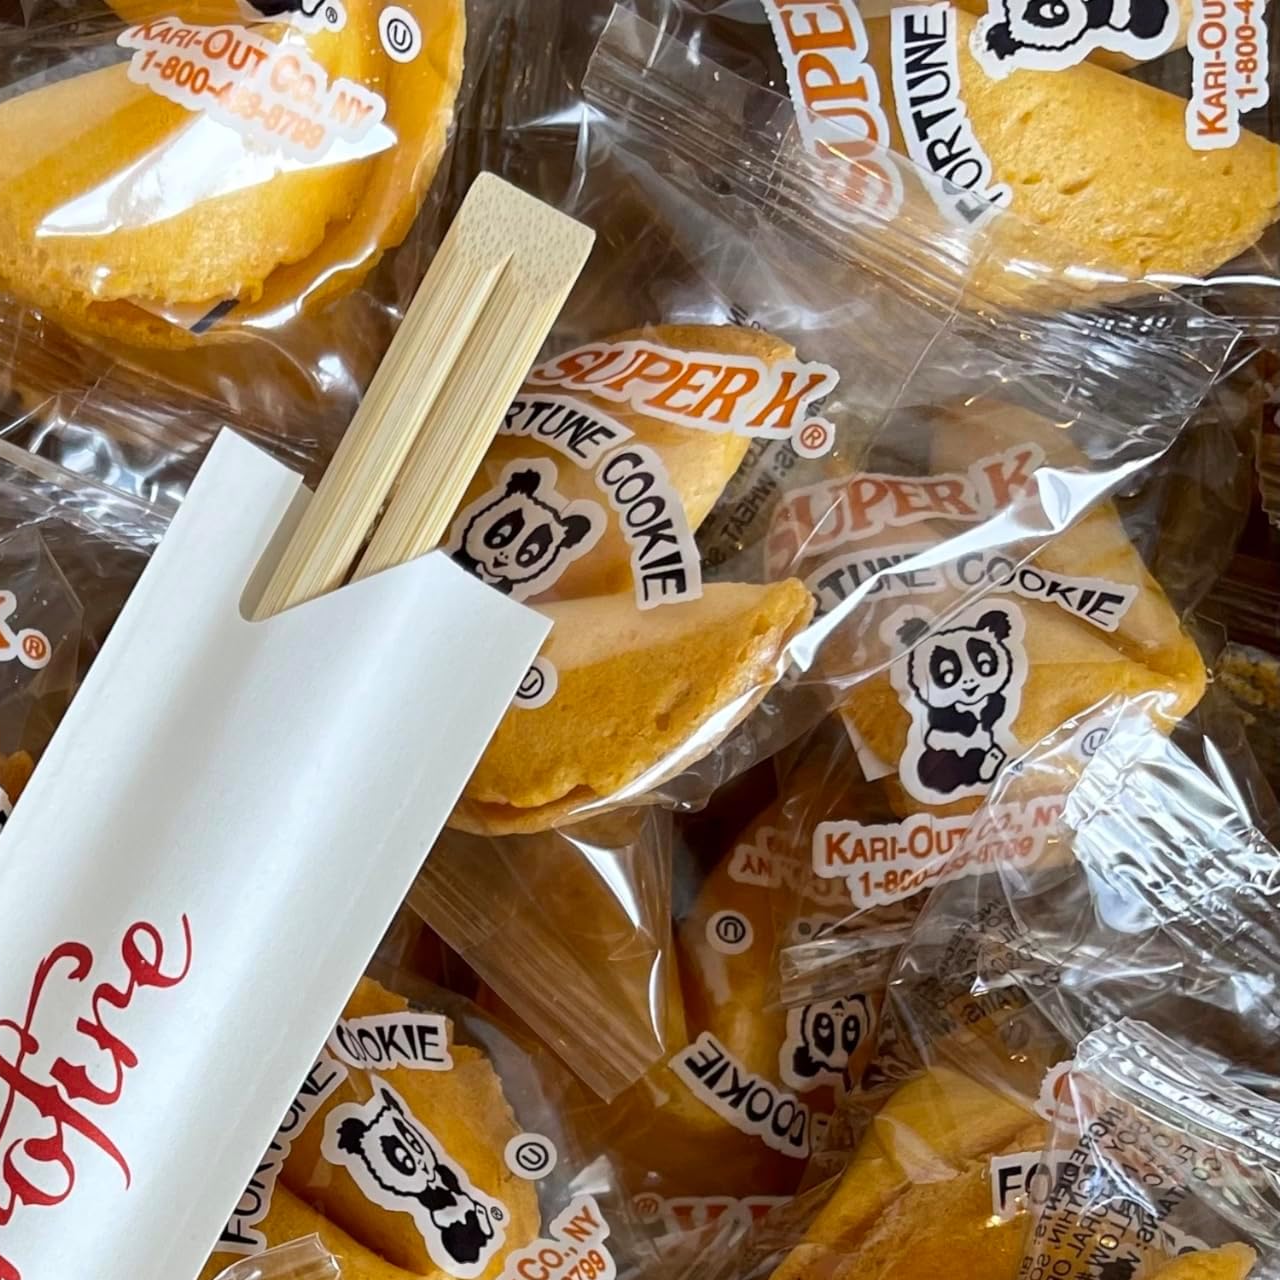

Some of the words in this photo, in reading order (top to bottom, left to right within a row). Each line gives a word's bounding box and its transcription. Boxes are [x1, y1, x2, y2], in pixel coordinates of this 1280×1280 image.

[132, 22, 268, 72] KARI-OUT
[903, 10, 1004, 224] FORTUNE
[532, 349, 759, 423] SUPER
[505, 401, 617, 459] RTUNE
[602, 452, 687, 602] COOKIE
[956, 552, 1125, 627] COOKIE
[825, 826, 970, 865] KARI-OUT
[336, 1024, 444, 1063] COOKIE
[682, 1037, 807, 1152] COOKIE
[219, 1062, 338, 1245] FORUNE
[562, 1205, 600, 1243] NY
